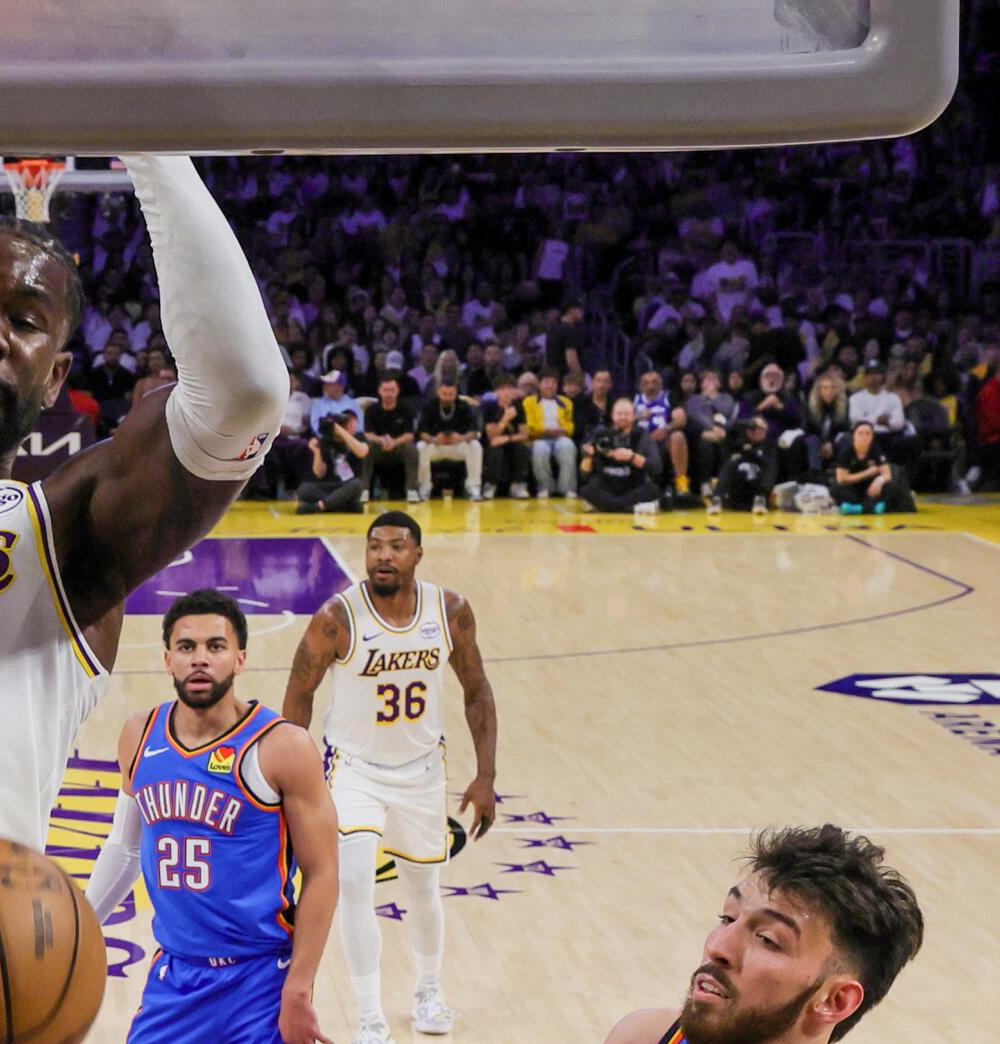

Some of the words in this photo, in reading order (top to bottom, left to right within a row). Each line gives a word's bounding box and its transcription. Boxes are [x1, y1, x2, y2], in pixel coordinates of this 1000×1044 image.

[17, 431, 81, 456] IA
[358, 647, 441, 677] LAKERS
[375, 680, 429, 726] 36
[133, 780, 244, 835] THUNDER
[155, 834, 212, 893] 25
